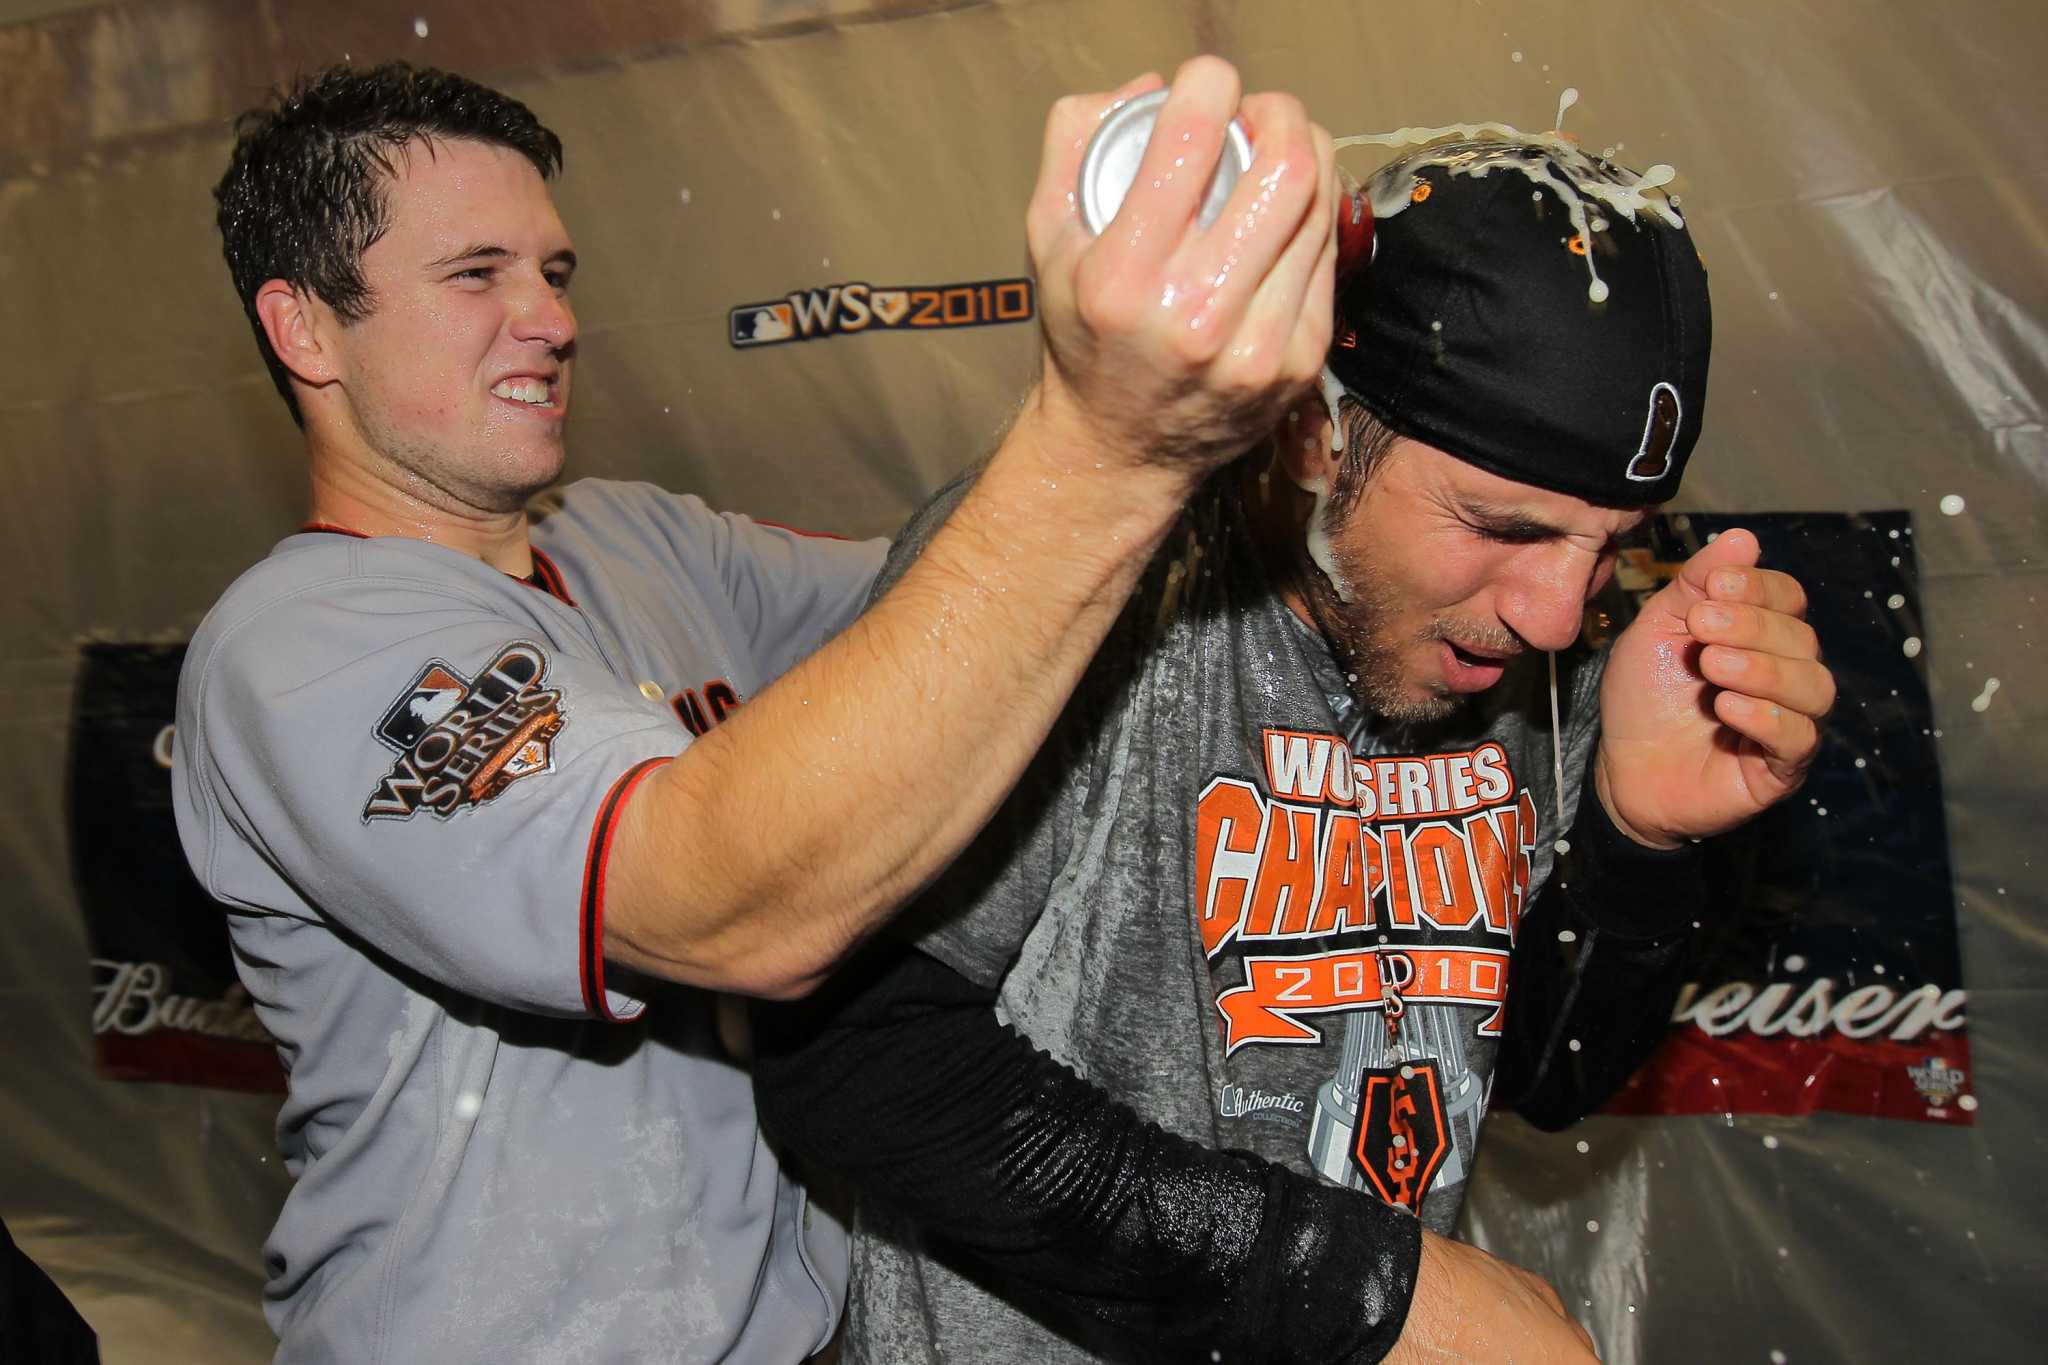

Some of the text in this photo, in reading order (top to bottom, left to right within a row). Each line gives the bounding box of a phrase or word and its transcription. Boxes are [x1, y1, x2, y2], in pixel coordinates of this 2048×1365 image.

[789, 282, 1031, 336] WS 2010
[367, 646, 544, 816] WORLD
[421, 688, 560, 812] SERIES
[1353, 746, 1511, 819] SERIES
[1234, 1086, 1304, 1118] Authentic
